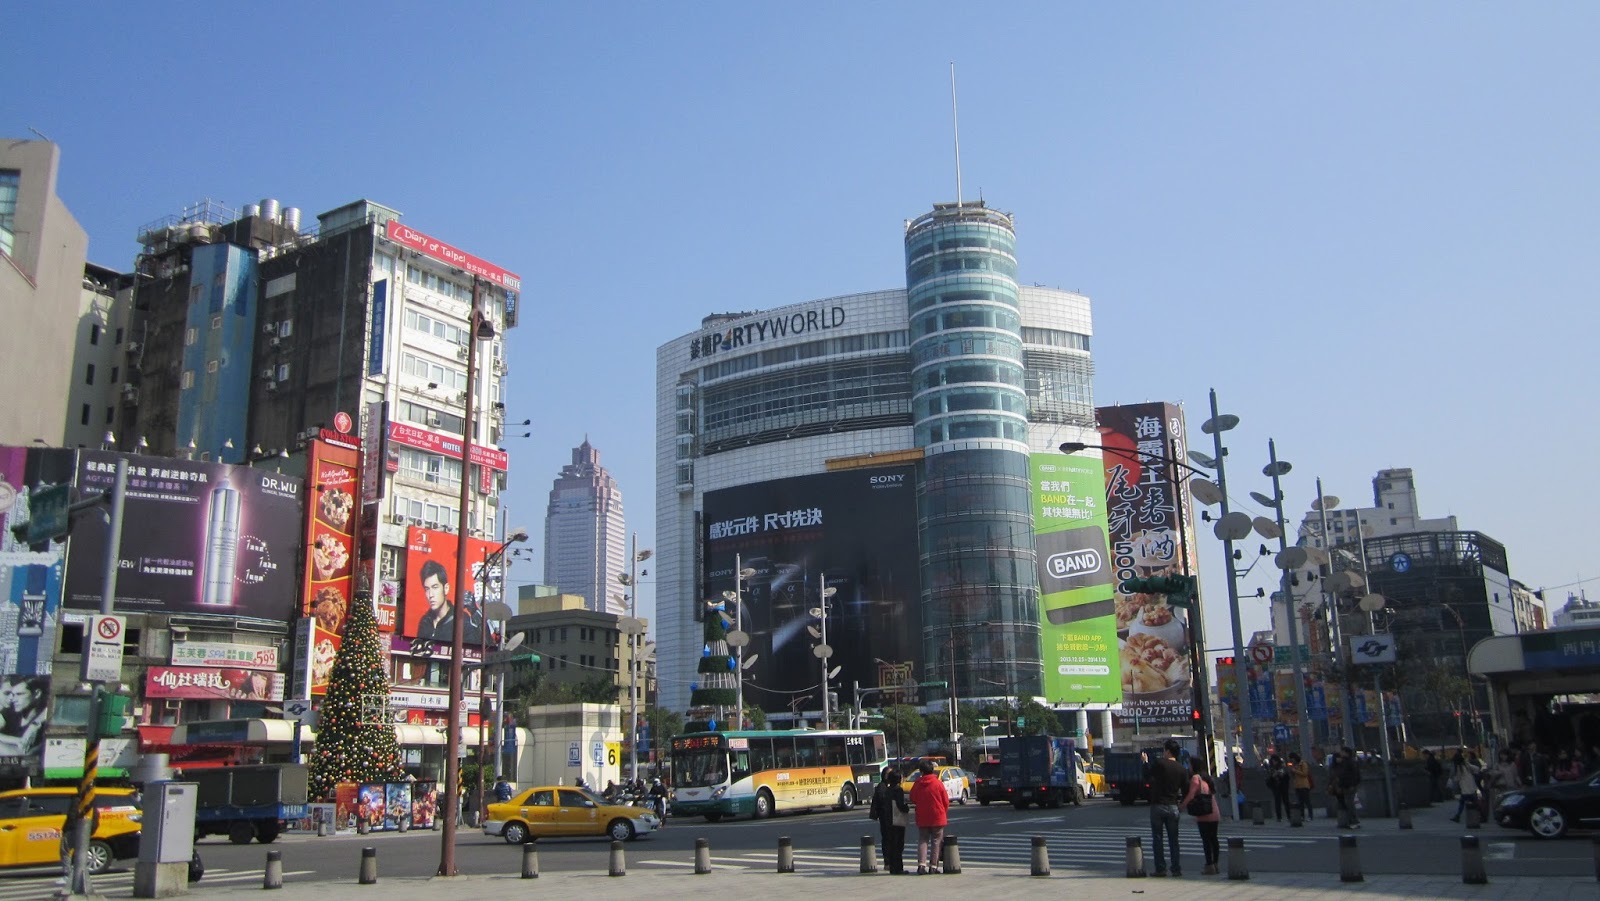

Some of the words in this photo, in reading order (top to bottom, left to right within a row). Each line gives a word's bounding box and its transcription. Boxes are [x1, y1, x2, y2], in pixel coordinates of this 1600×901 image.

[404, 228, 428, 246] Diary
[429, 243, 439, 252] of
[441, 245, 466, 263] Taipei
[712, 306, 846, 354] PARTYWORLD
[320, 428, 339, 440] COLD
[407, 436, 418, 444] Diary
[442, 441, 462, 453] HOTEL
[1134, 416, 1168, 485] 海霸王
[86, 461, 147, 476] 經典配升級
[262, 477, 297, 493] DR.WU
[869, 474, 905, 484] SONY
[262, 488, 278, 496] CLINICAL
[278, 490, 296, 499] SKINCARE
[1040, 480, 1071, 493] 當我們
[1040, 494, 1096, 508] BAND在一起
[1042, 506, 1093, 520] 其快樂無比!
[709, 515, 760, 540] 感光元件
[763, 507, 823, 532] 尺寸先決
[1053, 553, 1097, 573] BAND
[709, 568, 734, 578] SONY
[177, 647, 207, 659] 玉芙蓉
[208, 649, 226, 659] SPA
[1562, 639, 1600, 656] 西門
[608, 748, 616, 766] 6
